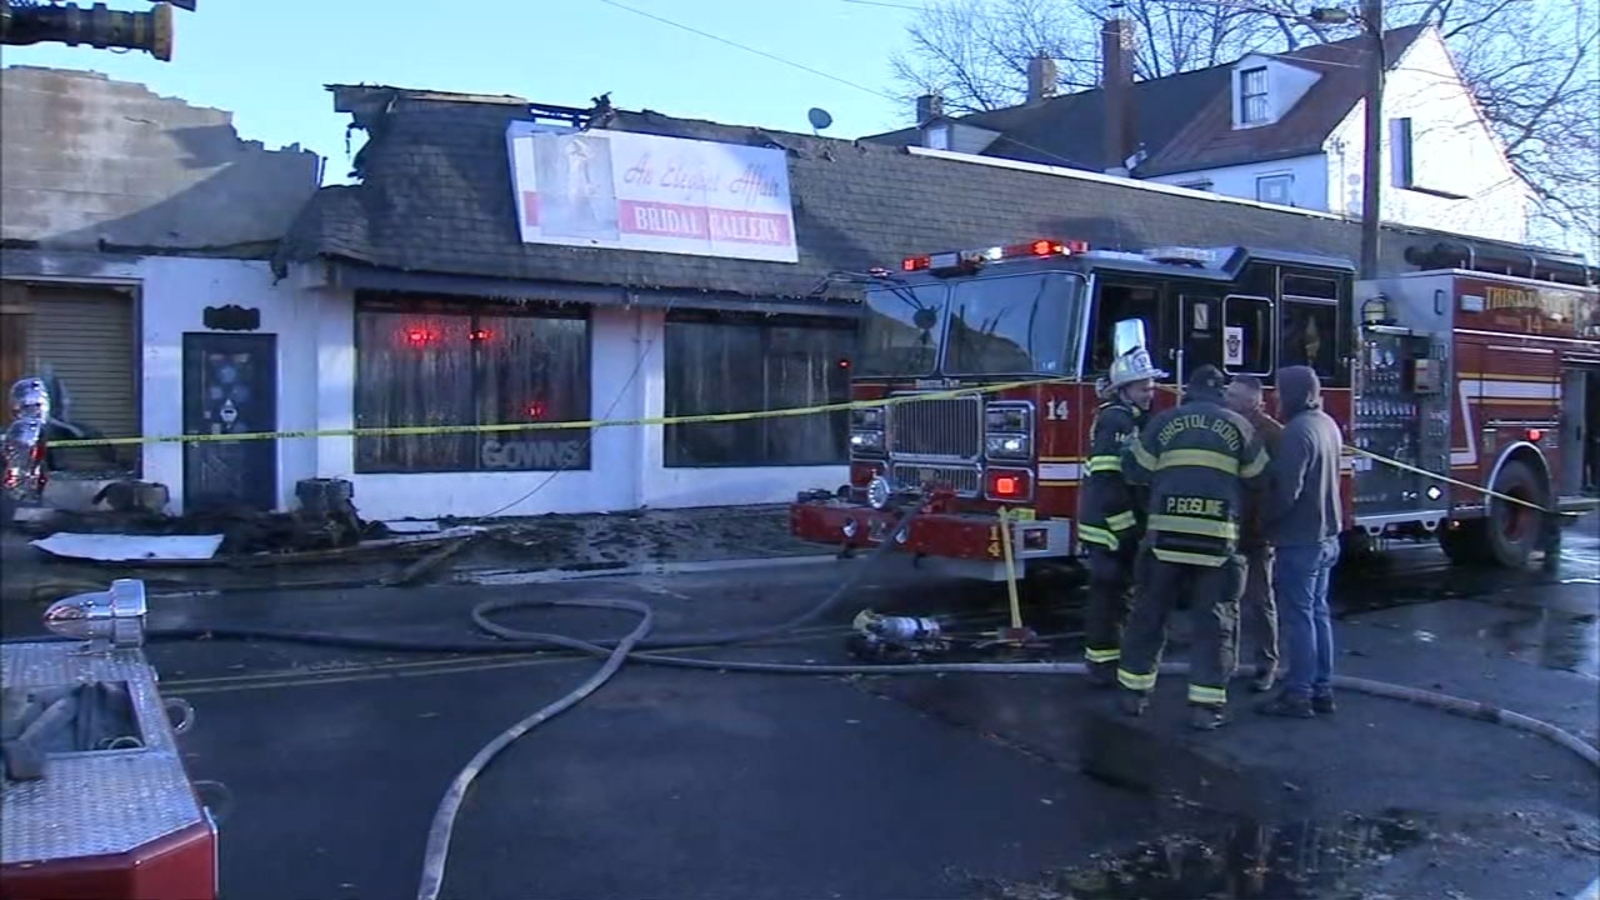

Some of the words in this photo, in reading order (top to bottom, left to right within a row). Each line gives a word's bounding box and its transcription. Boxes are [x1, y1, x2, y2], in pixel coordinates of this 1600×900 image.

[634, 206, 702, 235] BRIDAL
[1526, 314, 1543, 332] 14
[1047, 400, 1069, 421] 14
[1159, 414, 1209, 446] BRISTOL
[1210, 419, 1240, 451] BORO
[481, 438, 580, 467] GOWNS
